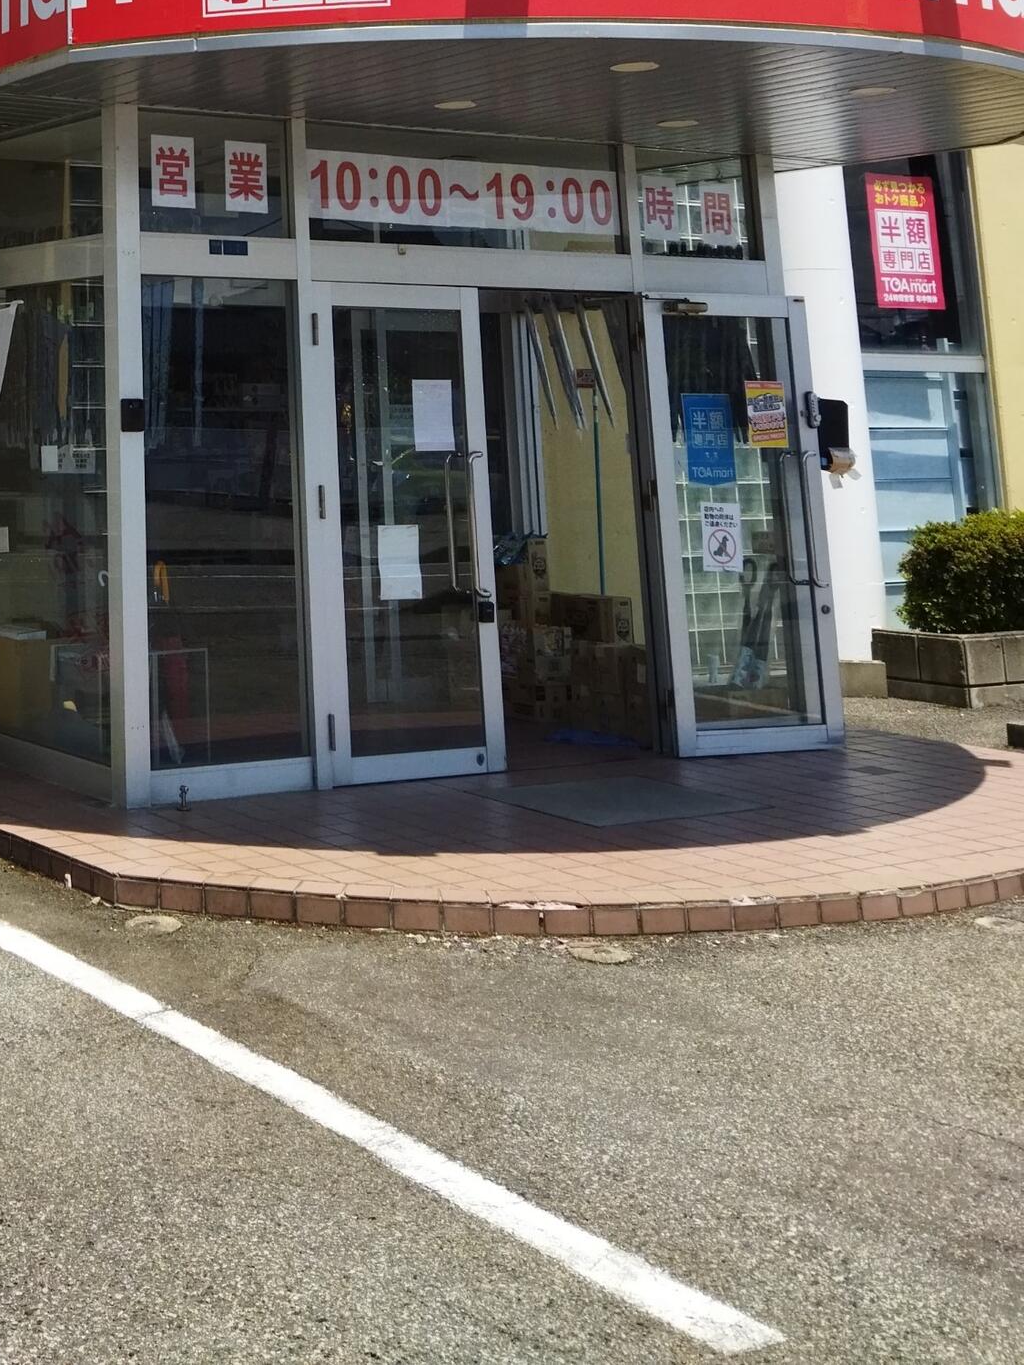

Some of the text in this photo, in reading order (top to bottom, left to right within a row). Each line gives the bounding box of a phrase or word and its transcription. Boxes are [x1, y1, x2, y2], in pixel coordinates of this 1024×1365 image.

[881, 216, 928, 244] 半額
[882, 250, 931, 270] 専門店
